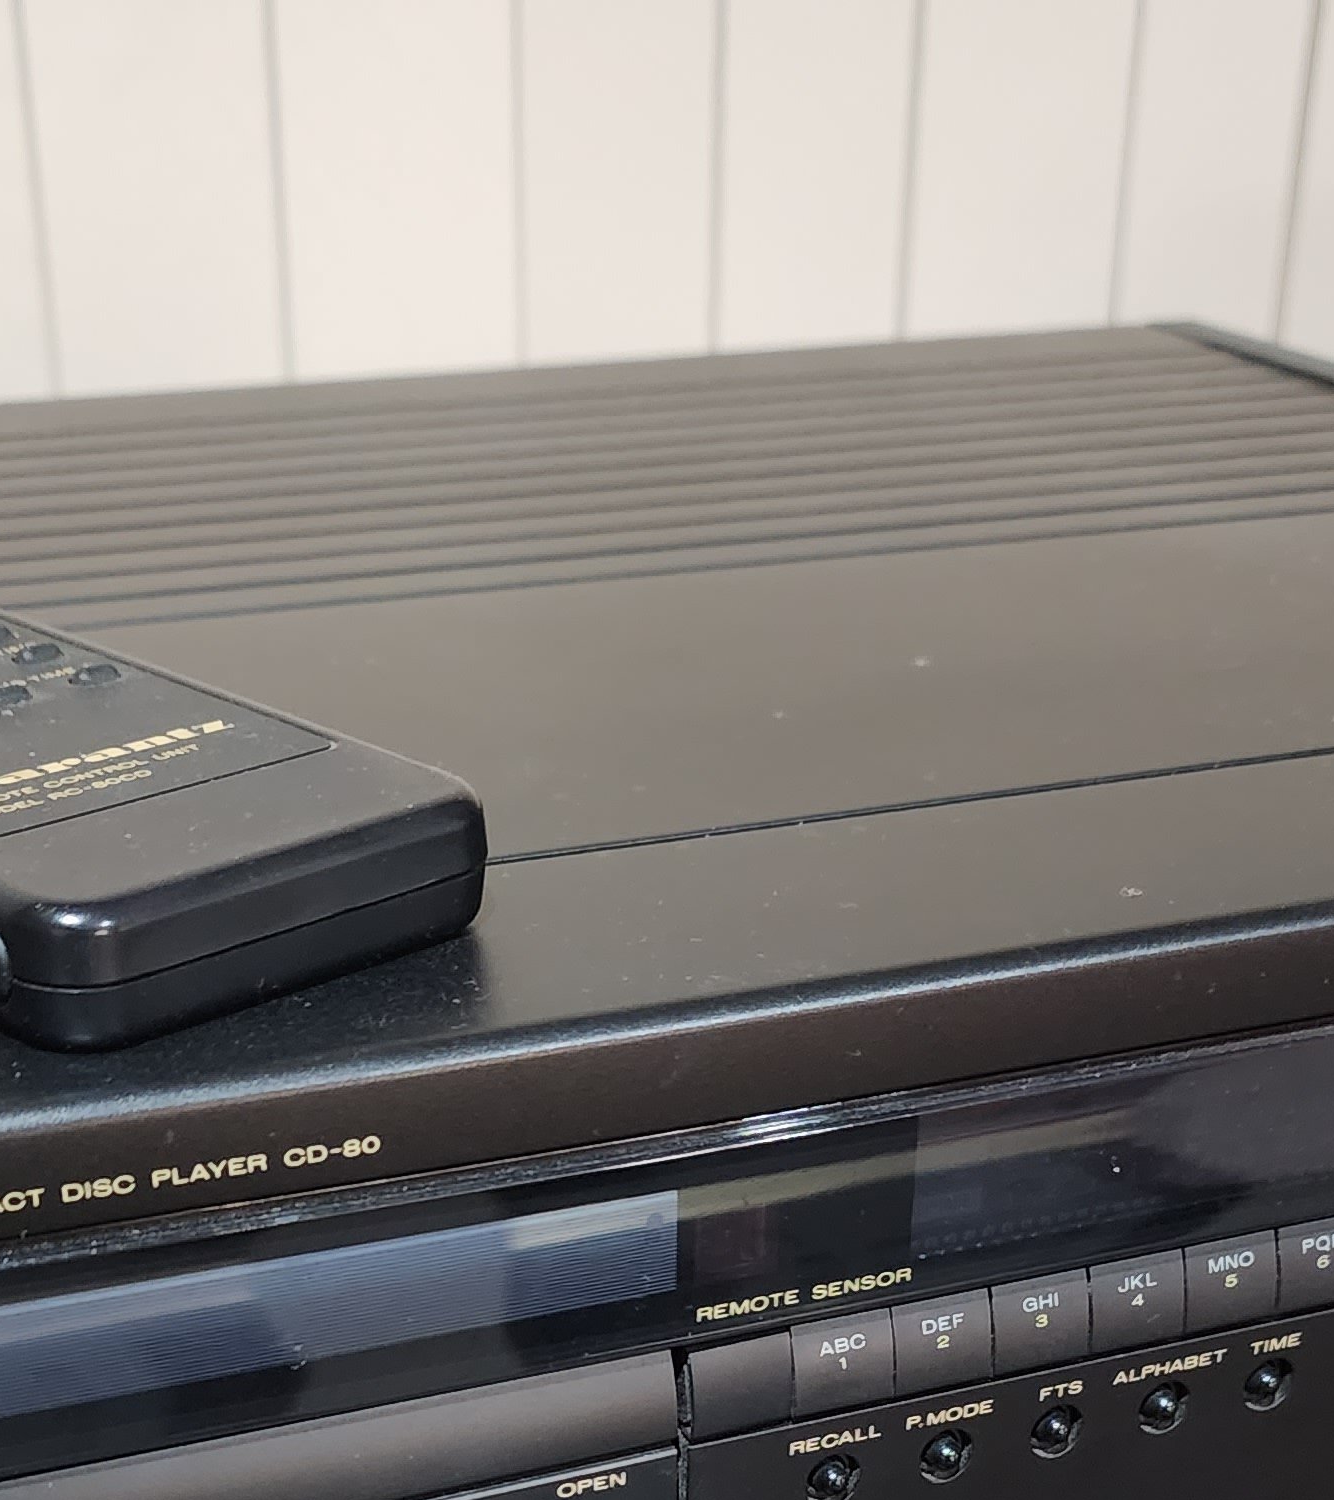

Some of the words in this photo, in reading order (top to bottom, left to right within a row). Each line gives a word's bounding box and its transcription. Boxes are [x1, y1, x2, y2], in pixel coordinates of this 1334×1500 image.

[43, 759, 148, 789] CONTROL
[152, 743, 199, 761] UNIT
[61, 1174, 136, 1204] DISC
[151, 1153, 268, 1188] PLAYER
[283, 1135, 381, 1168] CD-80
[1207, 1250, 1255, 1275] MNO
[1316, 1254, 1331, 1270] 6
[1117, 1272, 1158, 1294] JKL
[1224, 1274, 1238, 1289] 5
[695, 1289, 800, 1323] REMOTE
[811, 1267, 913, 1301] SENSOR
[1022, 1292, 1060, 1314] GHI
[1130, 1294, 1144, 1307] 4
[921, 1313, 965, 1336] DEF
[1034, 1313, 1049, 1328] 3
[819, 1333, 867, 1358] ABC
[936, 1334, 951, 1349] 2
[1250, 1331, 1303, 1355] TIME
[838, 1357, 848, 1371] 1
[1113, 1348, 1227, 1386] ALPHABET
[1038, 1380, 1083, 1402] FTS
[905, 1400, 994, 1431] P.MODE
[788, 1425, 881, 1457] RECALL
[556, 1471, 627, 1499] OPEN
